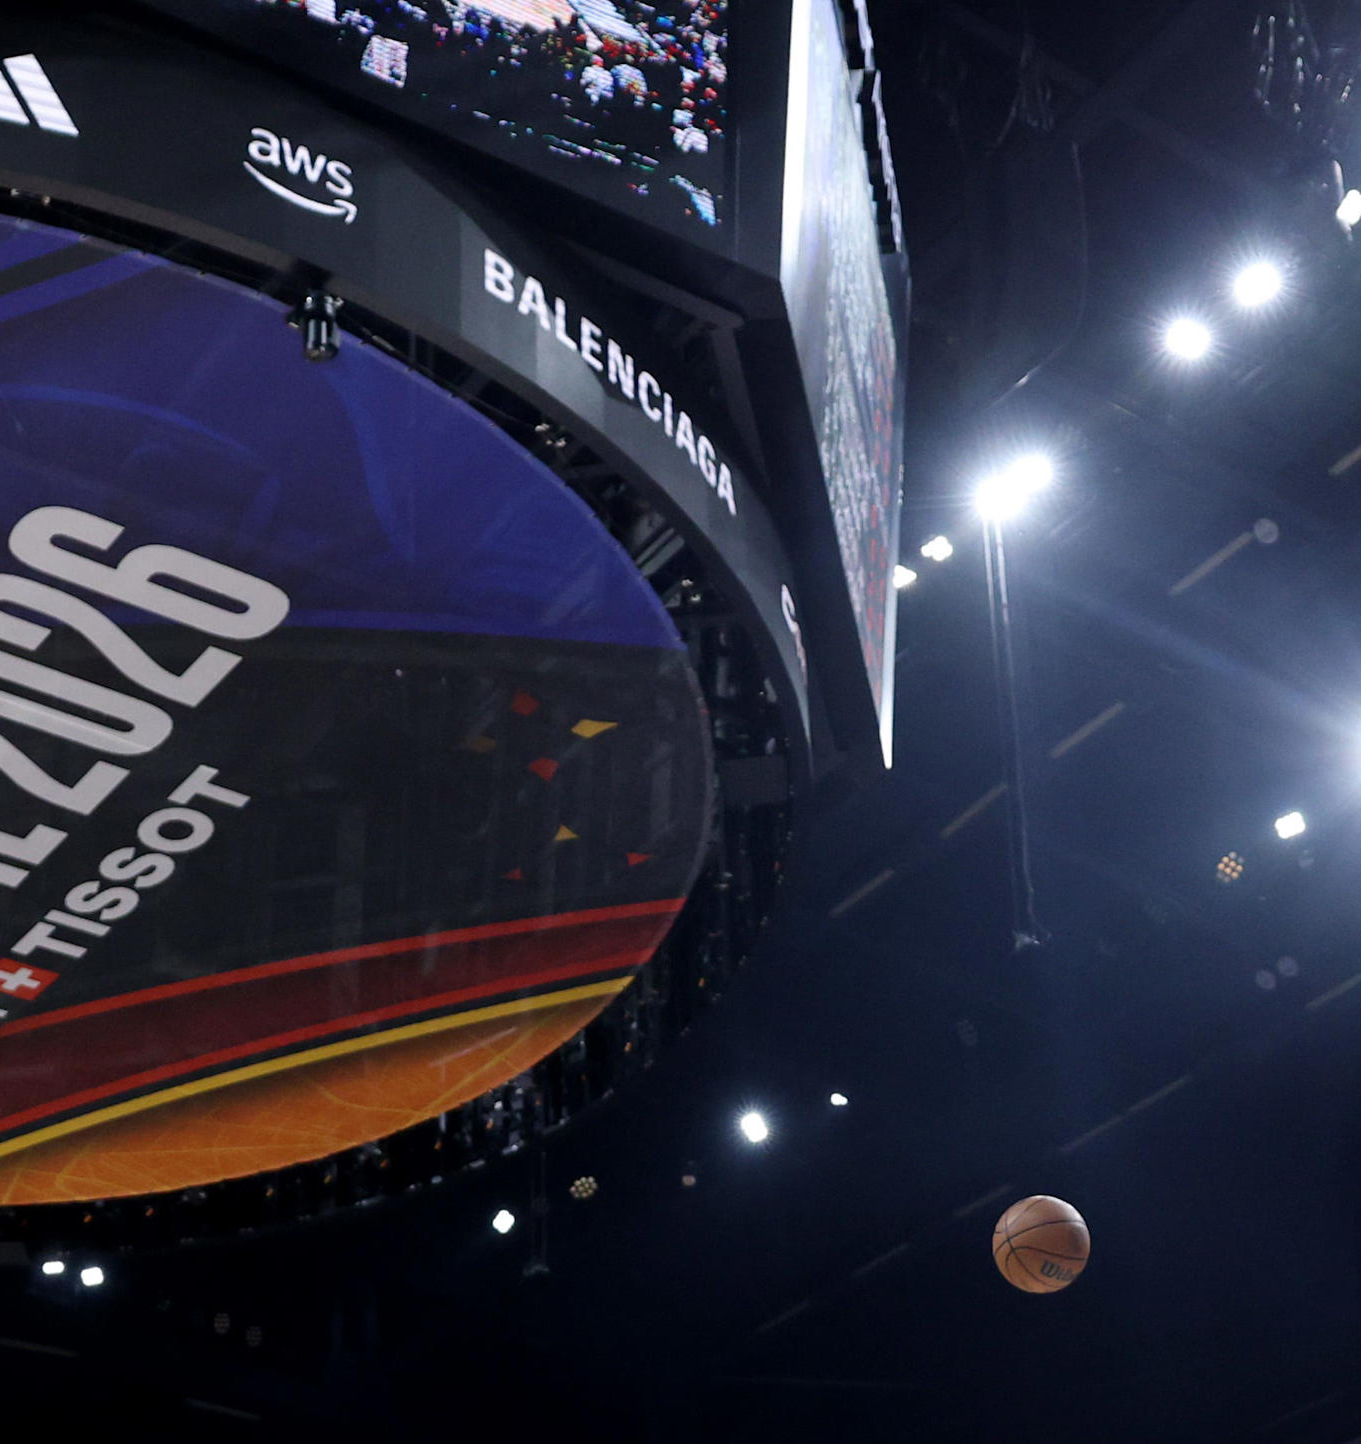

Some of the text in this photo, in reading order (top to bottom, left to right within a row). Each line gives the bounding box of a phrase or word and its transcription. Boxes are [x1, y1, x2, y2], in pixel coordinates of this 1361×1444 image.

[249, 127, 354, 195] aws
[484, 247, 737, 516] BALENCIAGA
[13, 765, 250, 962] TISSOT
